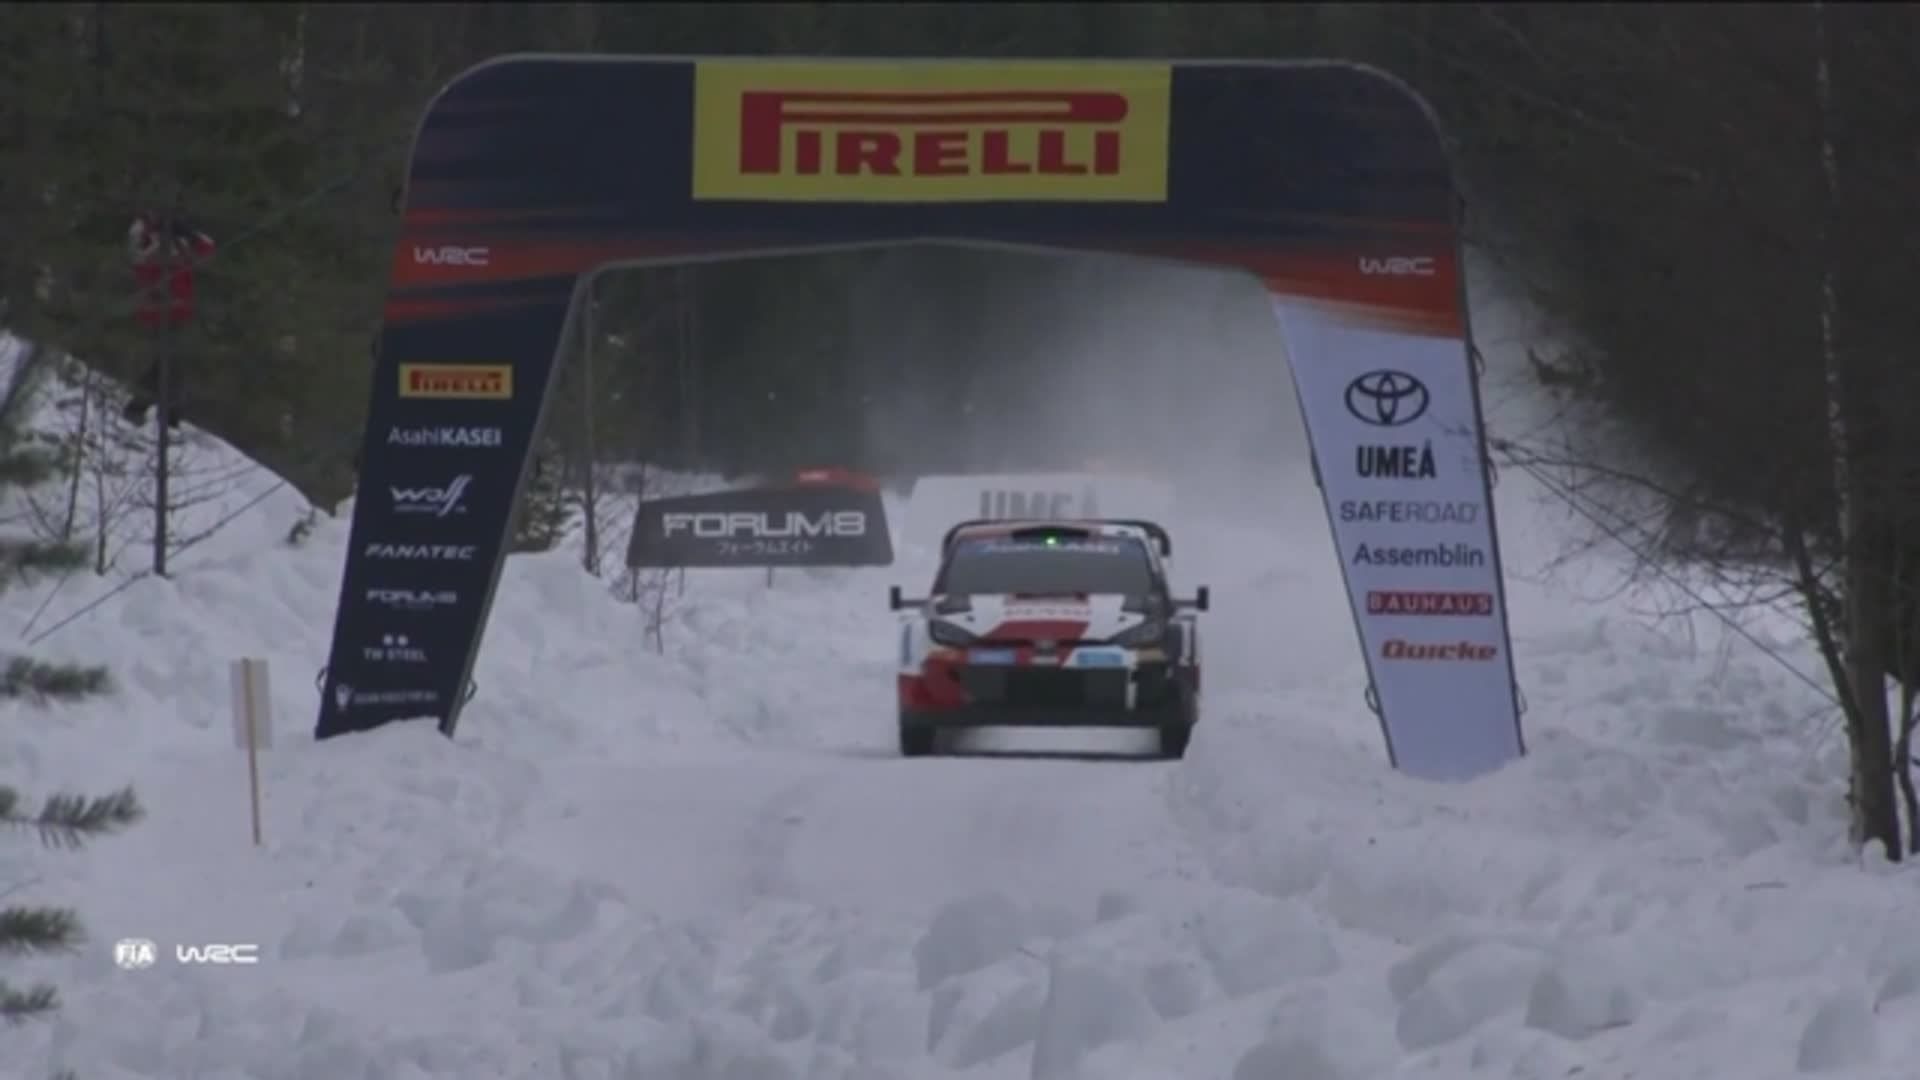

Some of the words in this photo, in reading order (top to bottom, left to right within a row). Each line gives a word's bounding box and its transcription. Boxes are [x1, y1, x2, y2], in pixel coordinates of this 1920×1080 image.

[740, 90, 1129, 176] PIRELLI
[413, 246, 489, 266] WRC
[1359, 256, 1436, 276] WRC
[387, 425, 503, 446] AsahiKASEI
[1356, 437, 1437, 479] UMEÅ
[1340, 499, 1478, 524] SAFEROAD
[662, 511, 866, 538] FORUM8
[364, 543, 476, 560] FANATEC
[1353, 542, 1485, 567] Assemblin
[1368, 592, 1491, 613] BAUHAUS
[1381, 638, 1497, 661] Quicke
